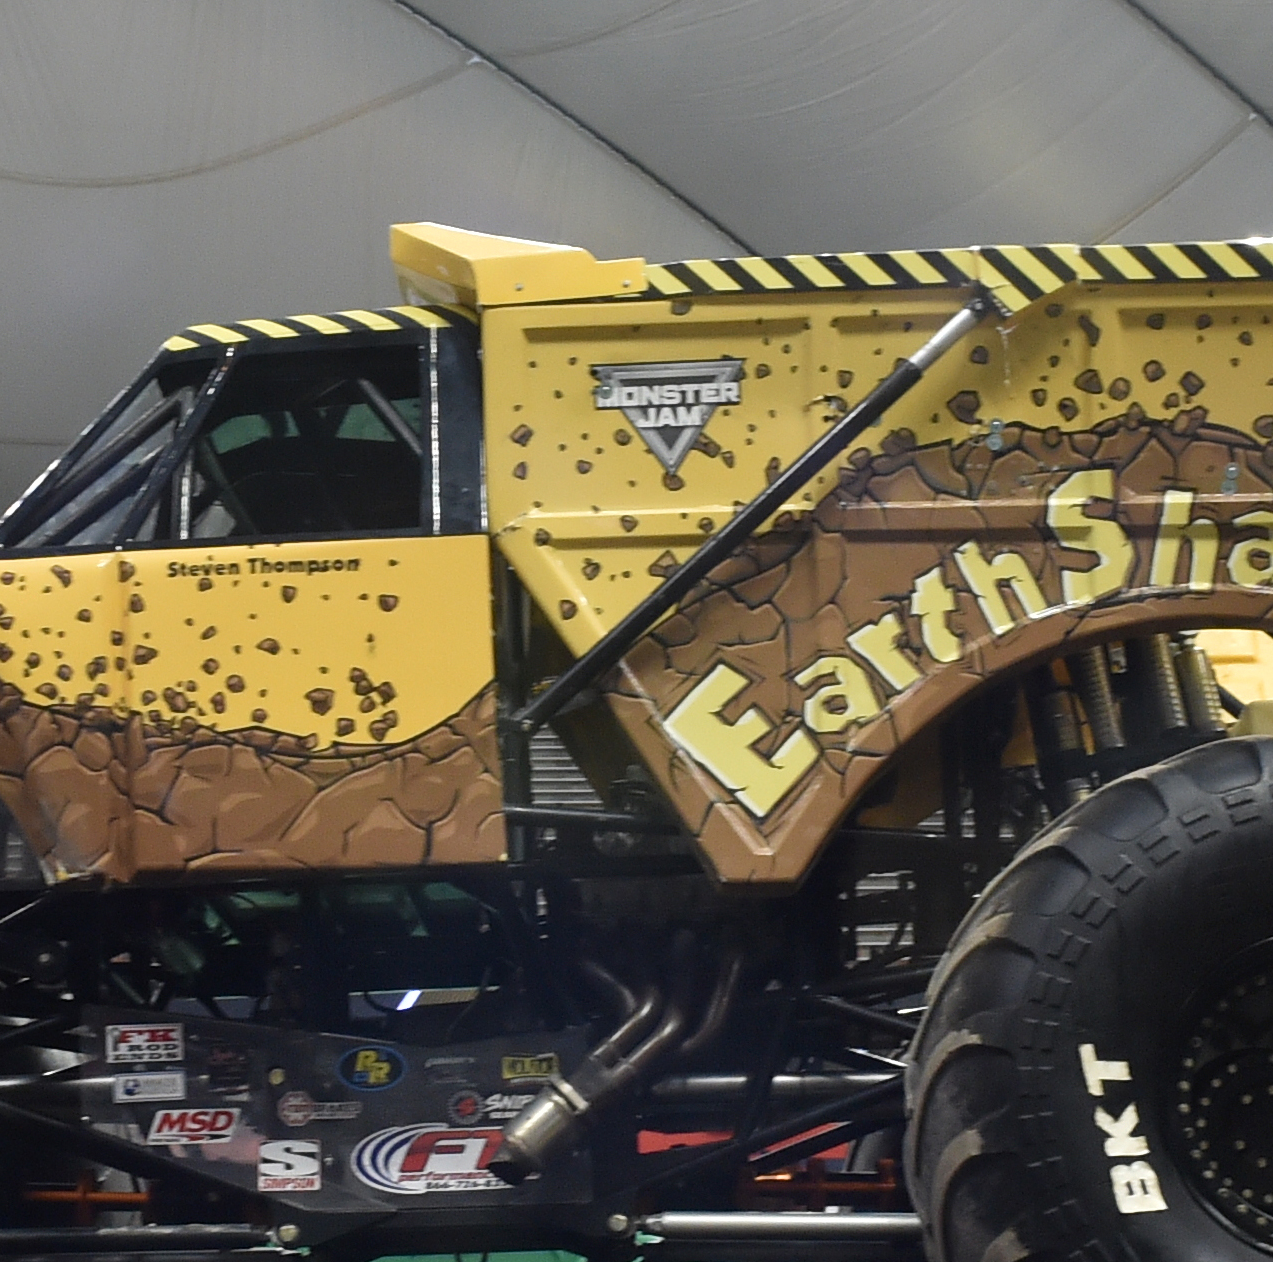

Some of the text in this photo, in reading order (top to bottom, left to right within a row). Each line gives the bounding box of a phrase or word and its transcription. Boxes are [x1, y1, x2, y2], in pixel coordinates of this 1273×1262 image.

[596, 382, 740, 408] MONSTER
[637, 406, 703, 428] JAM
[167, 557, 361, 578] Steven Thompson
[127, 1044, 178, 1052] ROD
[157, 1110, 235, 1133] MSD
[1079, 1044, 1168, 1214] BKT
[259, 1140, 320, 1177] S
[261, 1177, 316, 1190] SIMPSON
